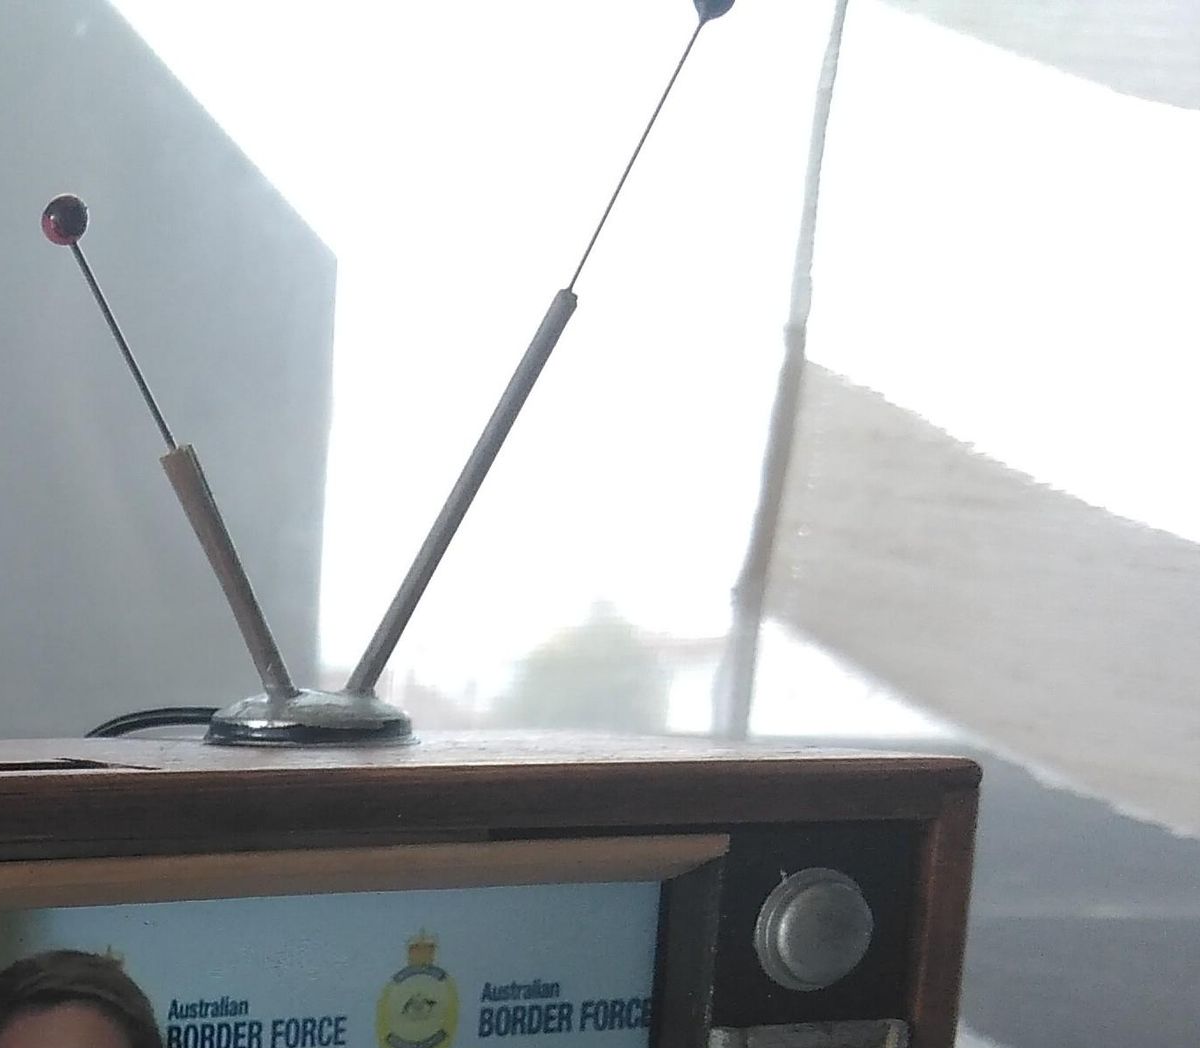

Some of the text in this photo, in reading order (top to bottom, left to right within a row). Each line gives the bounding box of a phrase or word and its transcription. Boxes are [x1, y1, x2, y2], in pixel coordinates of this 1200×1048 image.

[481, 979, 561, 1002] Australian
[167, 996, 249, 1020] Australian
[478, 1002, 574, 1038] BORDER
